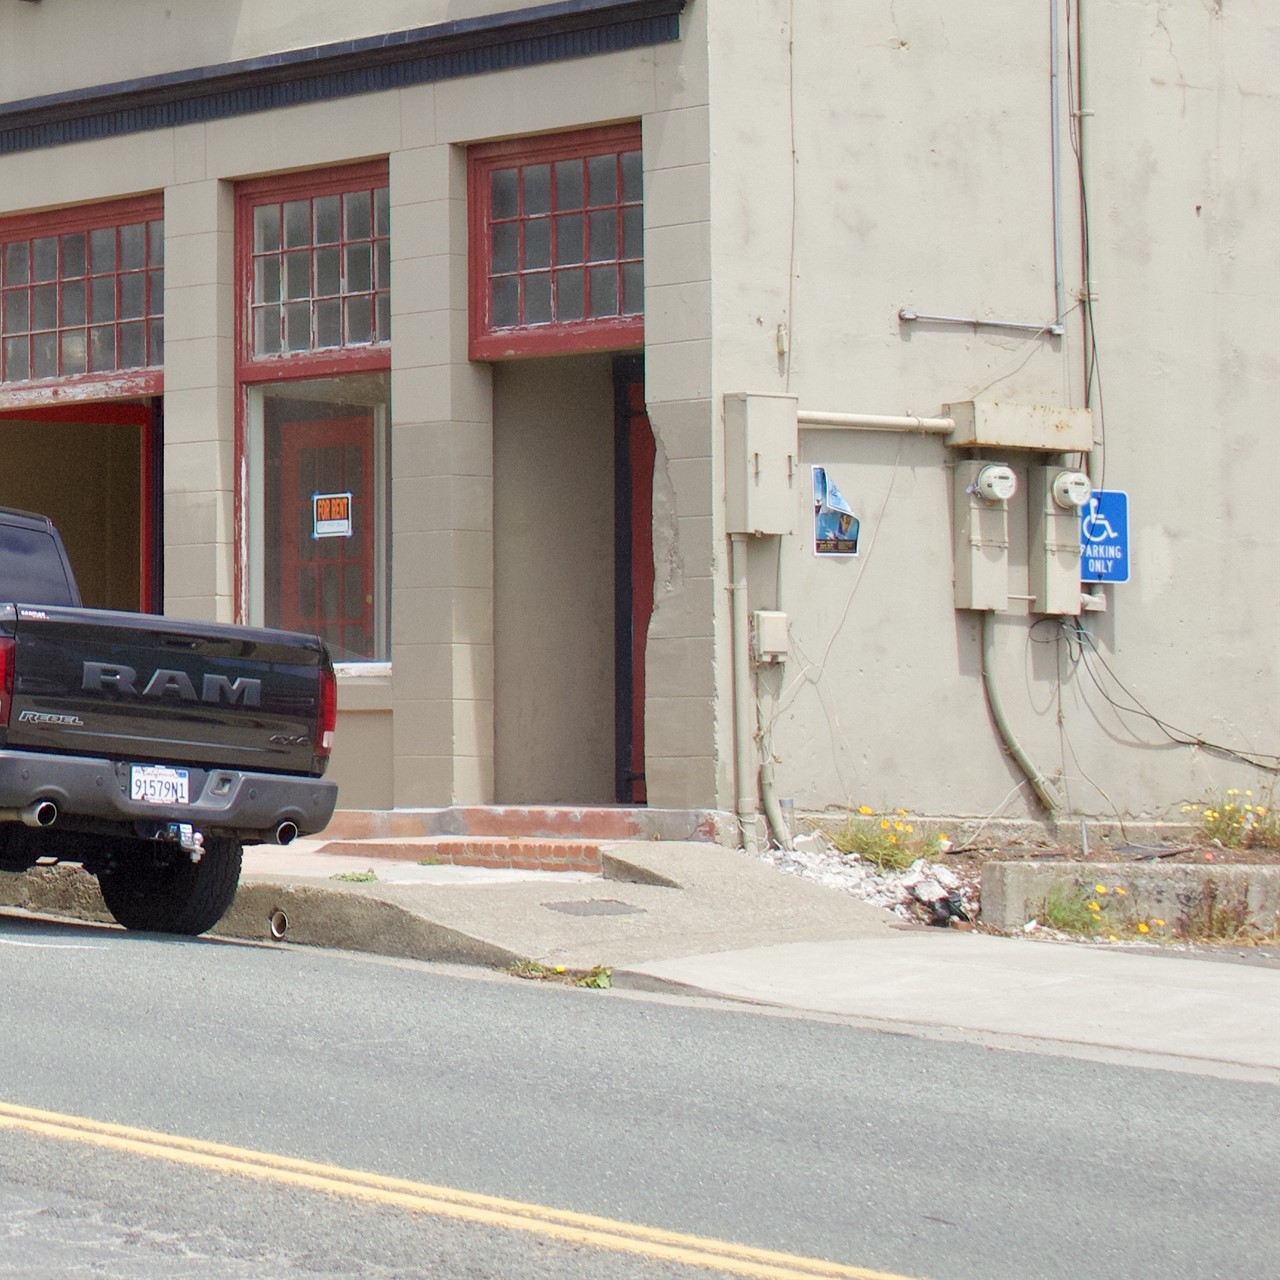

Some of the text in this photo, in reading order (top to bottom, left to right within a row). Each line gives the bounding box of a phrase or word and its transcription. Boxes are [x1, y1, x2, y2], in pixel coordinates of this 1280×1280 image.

[317, 498, 348, 521] FOR RENT
[1088, 559, 1114, 573] ONLY
[81, 661, 262, 707] RAM
[18, 710, 84, 726] REBEL
[134, 778, 185, 799] 91579N1
